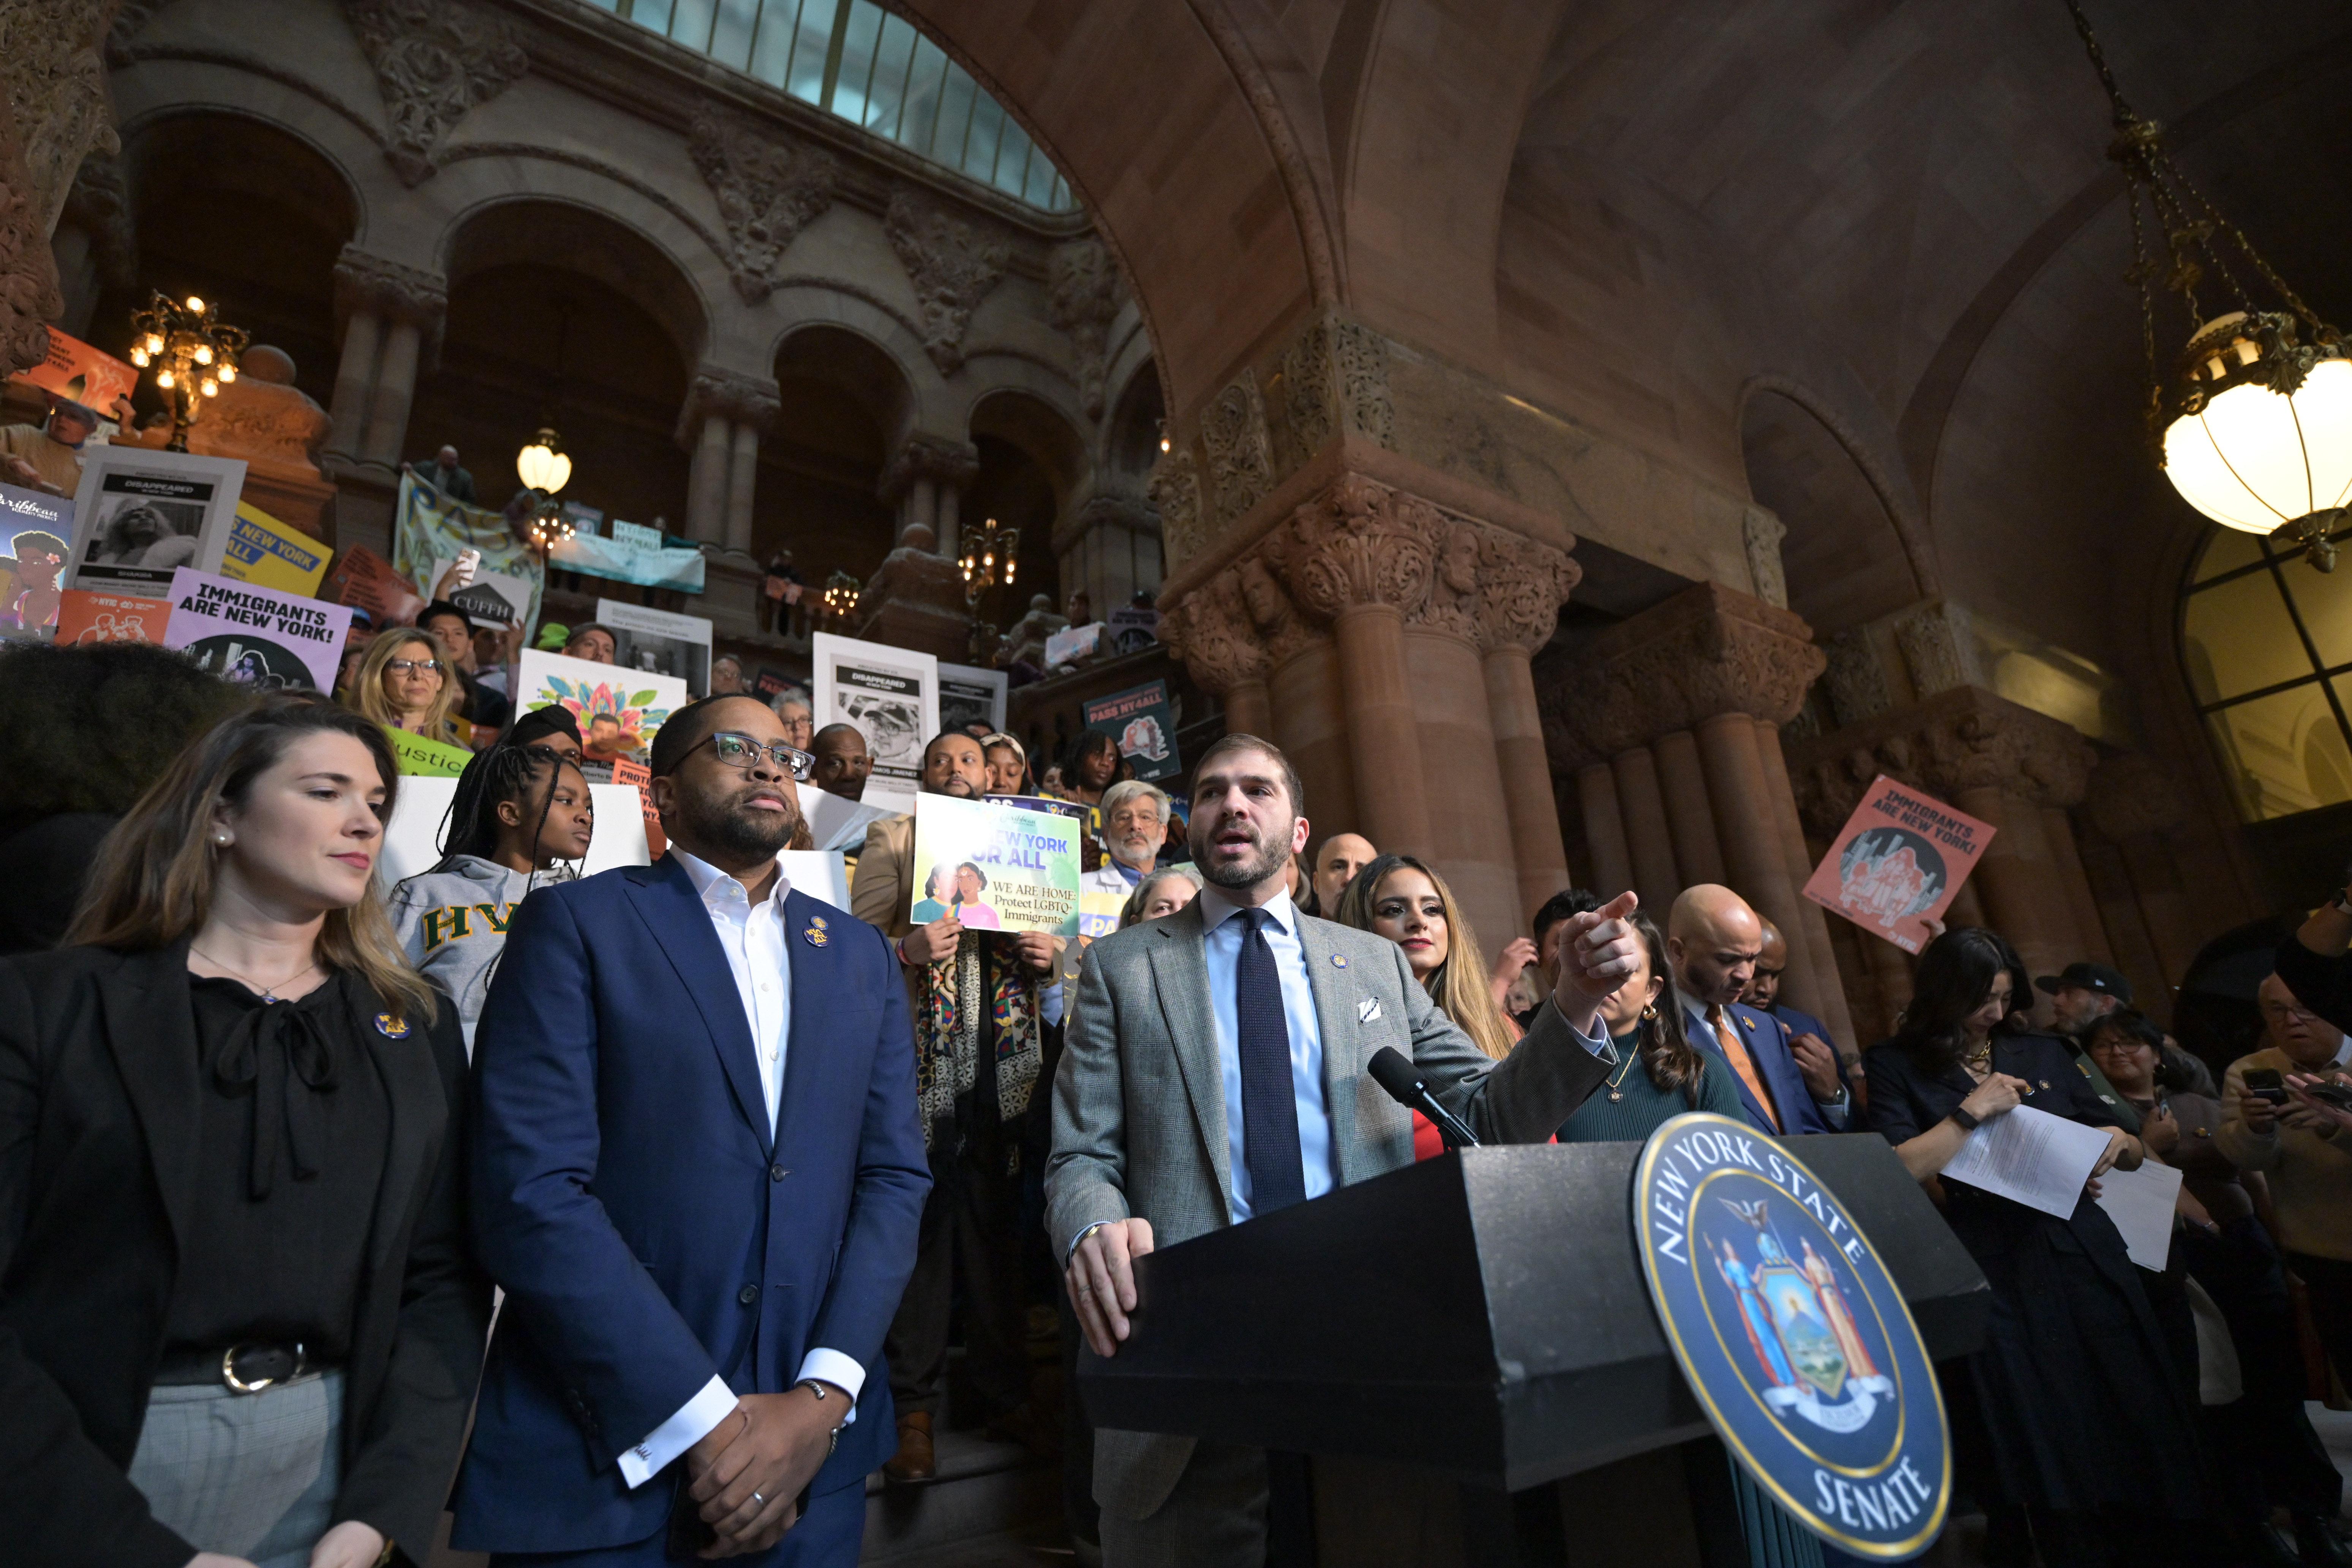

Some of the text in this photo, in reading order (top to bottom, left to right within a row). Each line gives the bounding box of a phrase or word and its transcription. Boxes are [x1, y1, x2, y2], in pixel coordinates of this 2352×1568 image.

[125, 480, 194, 493] DISAPPEARED
[240, 524, 277, 548] NEW
[277, 541, 315, 569] YORK
[197, 583, 327, 626] IMMIGRANTS
[454, 595, 508, 618] CUFFH
[179, 597, 334, 643] ARE NEW YORK!
[852, 672, 906, 689] DISAPPEARED
[1089, 706, 1119, 723] PASS
[1120, 692, 1163, 714] NY4ALL
[1872, 799, 1977, 855] ARE NEW YORK!
[1886, 789, 1974, 839] IMMIGRANTS
[1025, 833, 1068, 854] YORK
[1007, 847, 1046, 870] ALL
[993, 881, 1076, 901] WE ARE HOME:
[995, 894, 1073, 915] Protect LGBTQ+
[1005, 908, 1063, 925] Immigrants
[1655, 1156, 1691, 1265] NEW
[1674, 1130, 1764, 1173] YORK
[1768, 1154, 1866, 1265] STATE
[1814, 1455, 1932, 1532] SENATE
